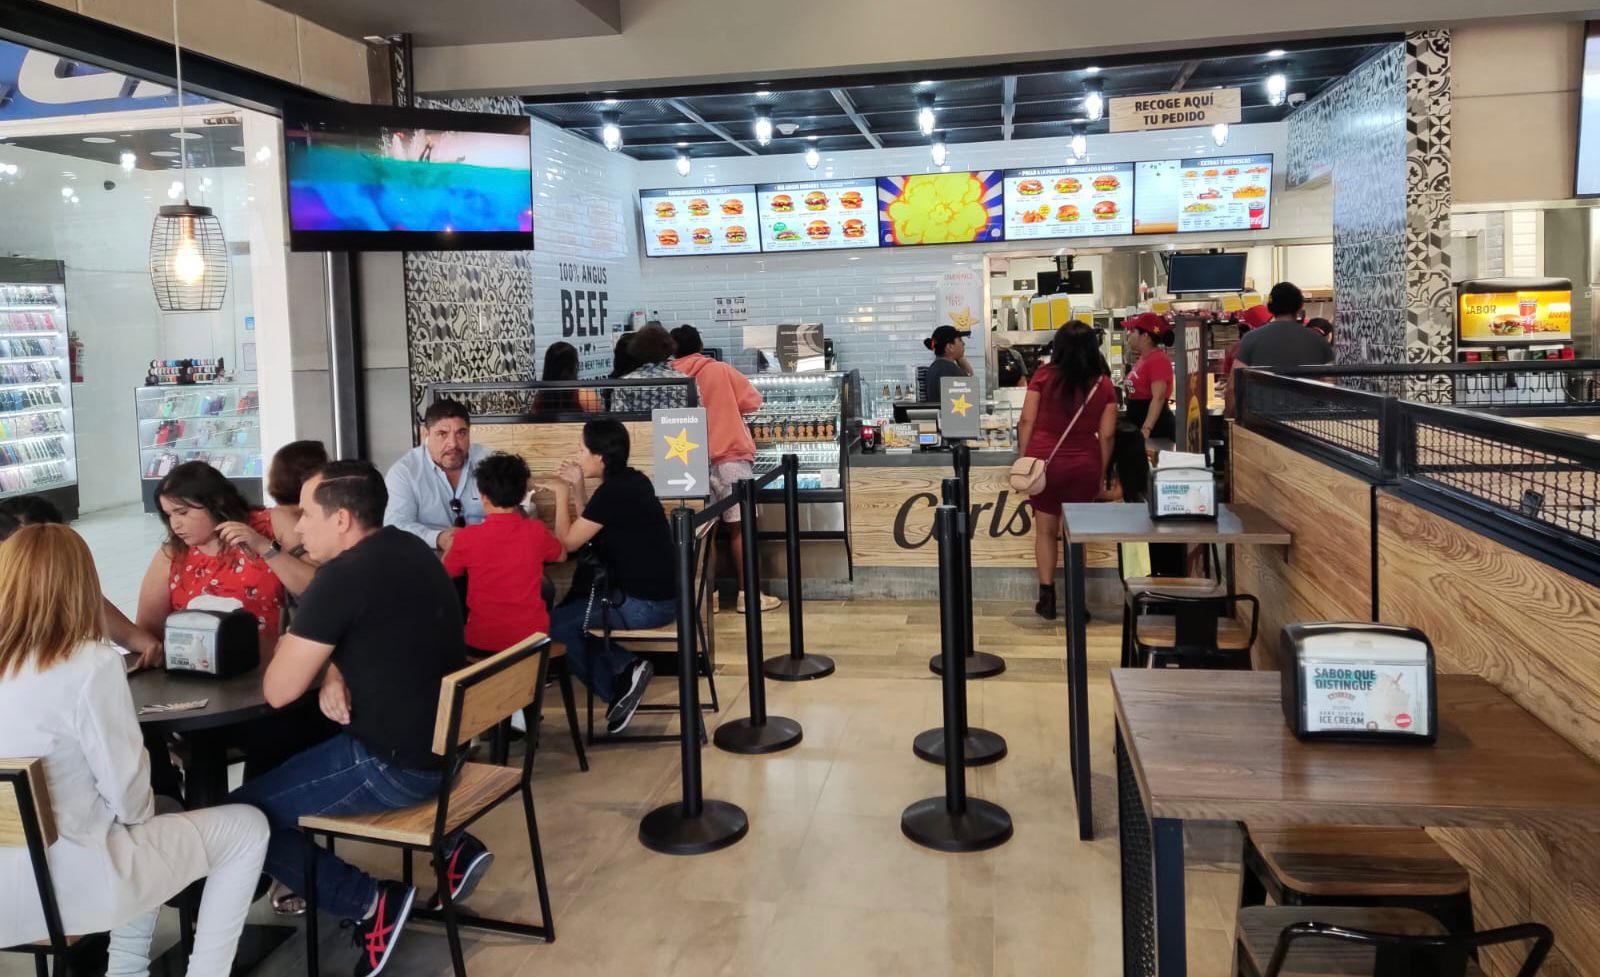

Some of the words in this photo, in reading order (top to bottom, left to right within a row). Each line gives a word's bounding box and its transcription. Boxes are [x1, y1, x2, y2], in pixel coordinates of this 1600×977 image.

[1135, 98, 1181, 112] RECOGE
[1184, 92, 1214, 107] AQUÍ
[1143, 114, 1158, 125] TU
[1162, 110, 1206, 124] PEDIDO
[559, 262, 580, 283] 100%
[582, 264, 607, 285] ANGUS
[560, 289, 608, 338] BEEF
[660, 415, 699, 425] Bienvenido
[892, 490, 1033, 549] Crls
[1314, 667, 1352, 680] SABOR
[1354, 669, 1376, 681] QUE
[1315, 679, 1373, 691] DISTINGUE
[1320, 716, 1333, 724] ICE
[1334, 716, 1364, 725] CREAM
